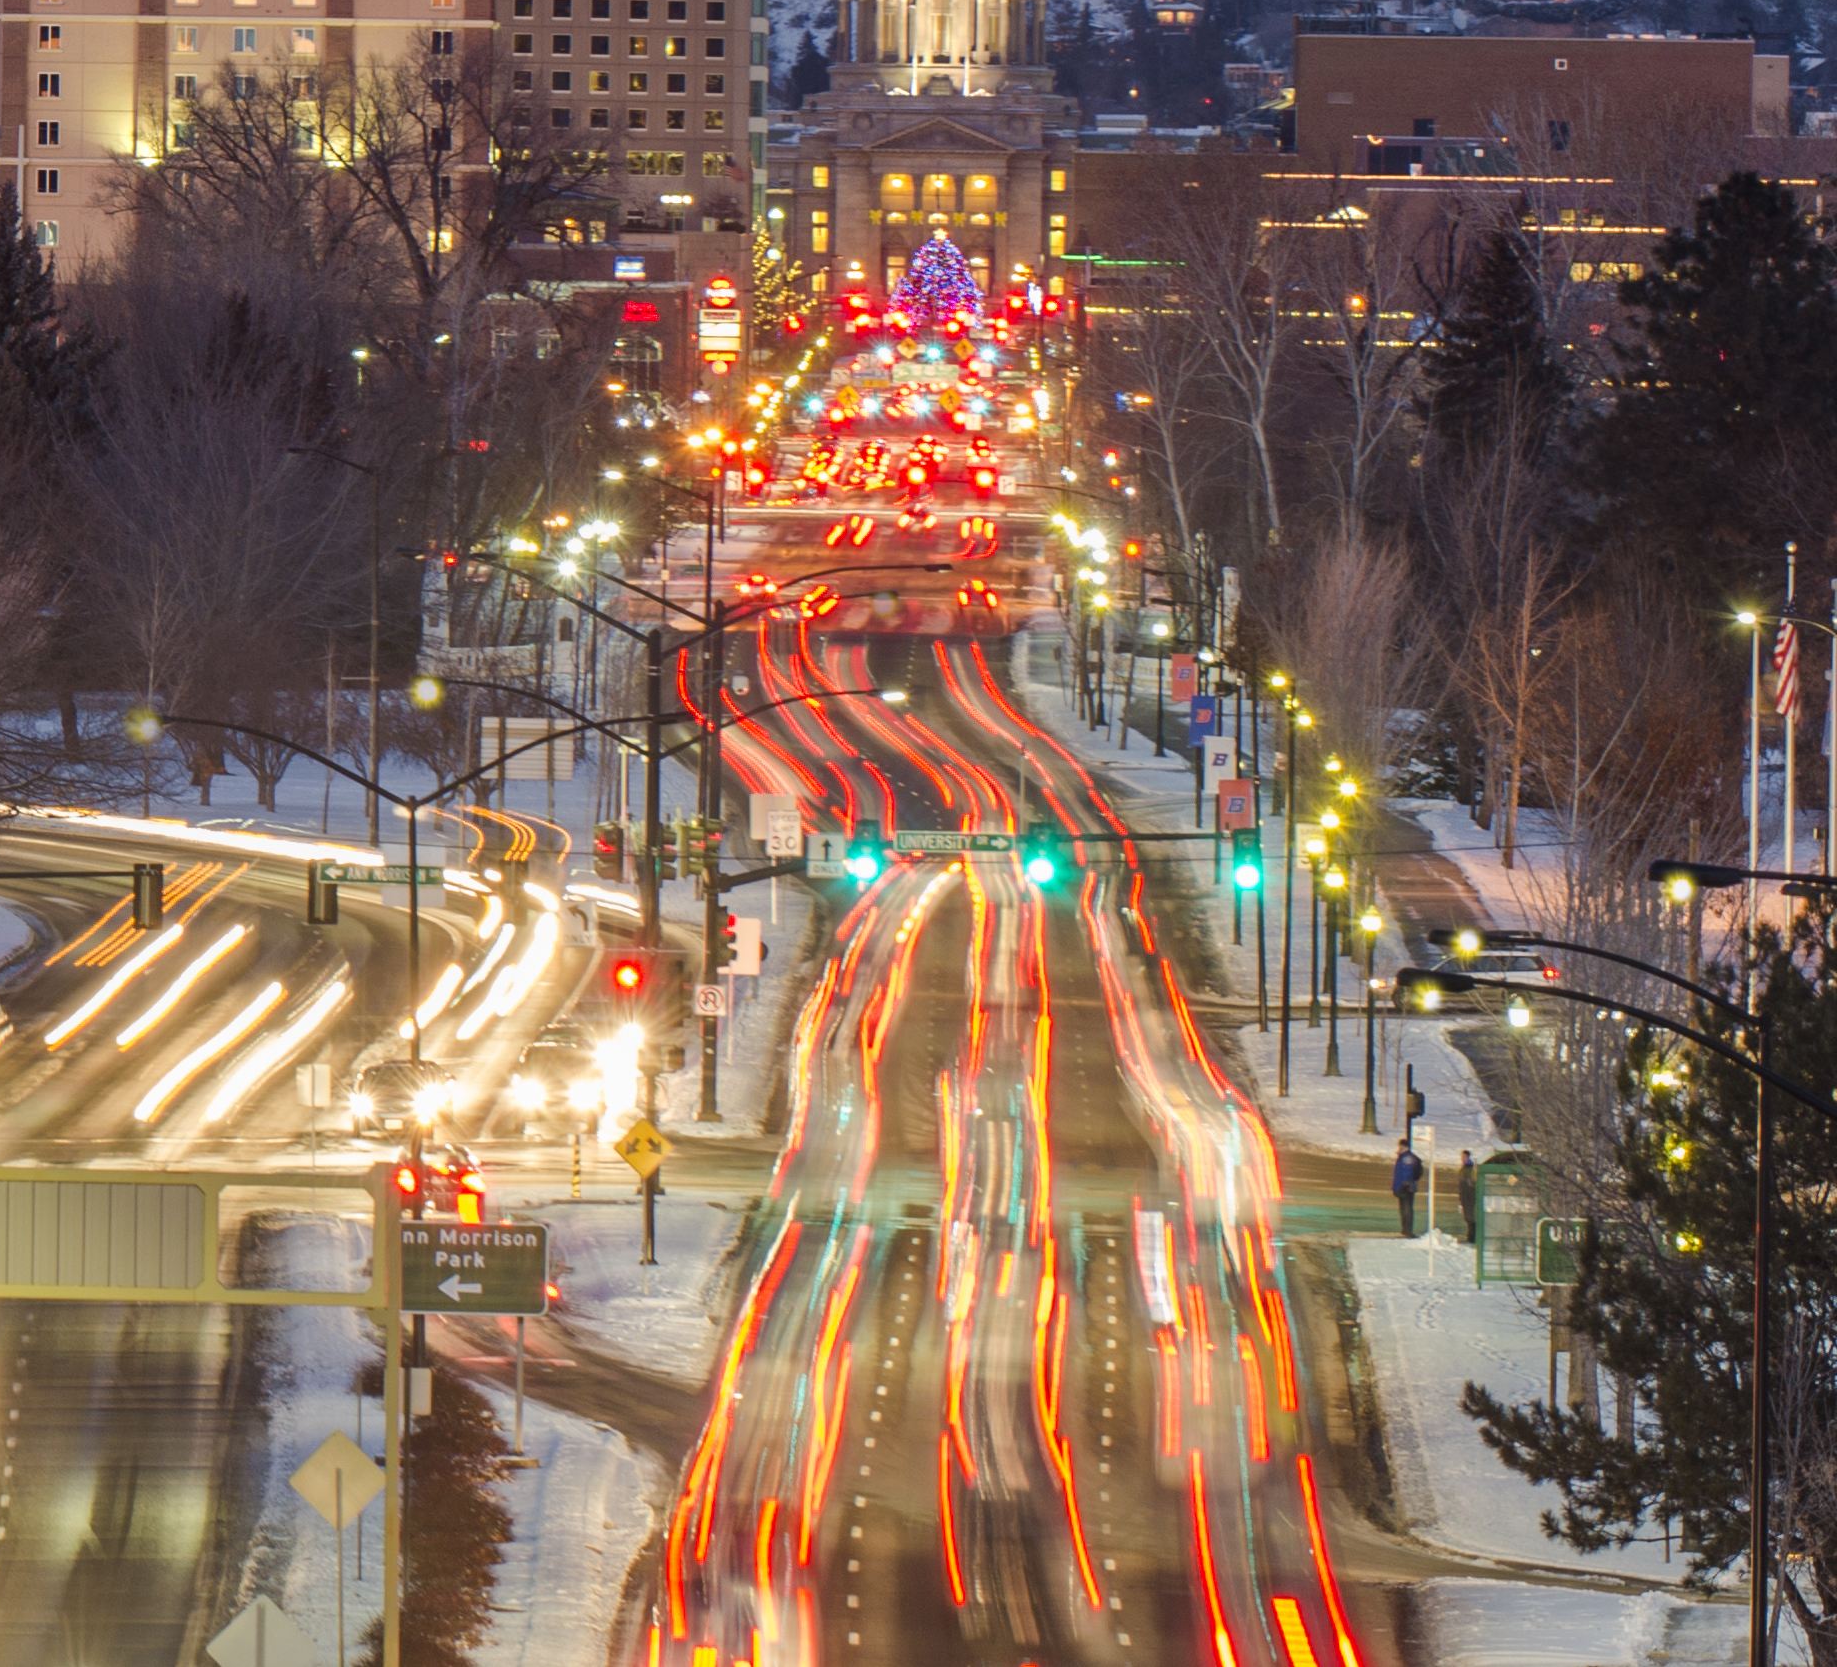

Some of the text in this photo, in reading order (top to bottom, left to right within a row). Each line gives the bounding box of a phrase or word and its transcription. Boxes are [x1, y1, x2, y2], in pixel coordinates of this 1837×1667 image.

[1212, 752, 1229, 767] B
[1226, 797, 1246, 814] B
[770, 835, 797, 850] 30
[899, 834, 973, 850] UNIVERSITY
[372, 866, 427, 882] MORRISN
[402, 1229, 538, 1247] nn Morrison
[435, 1251, 486, 1269] Park
